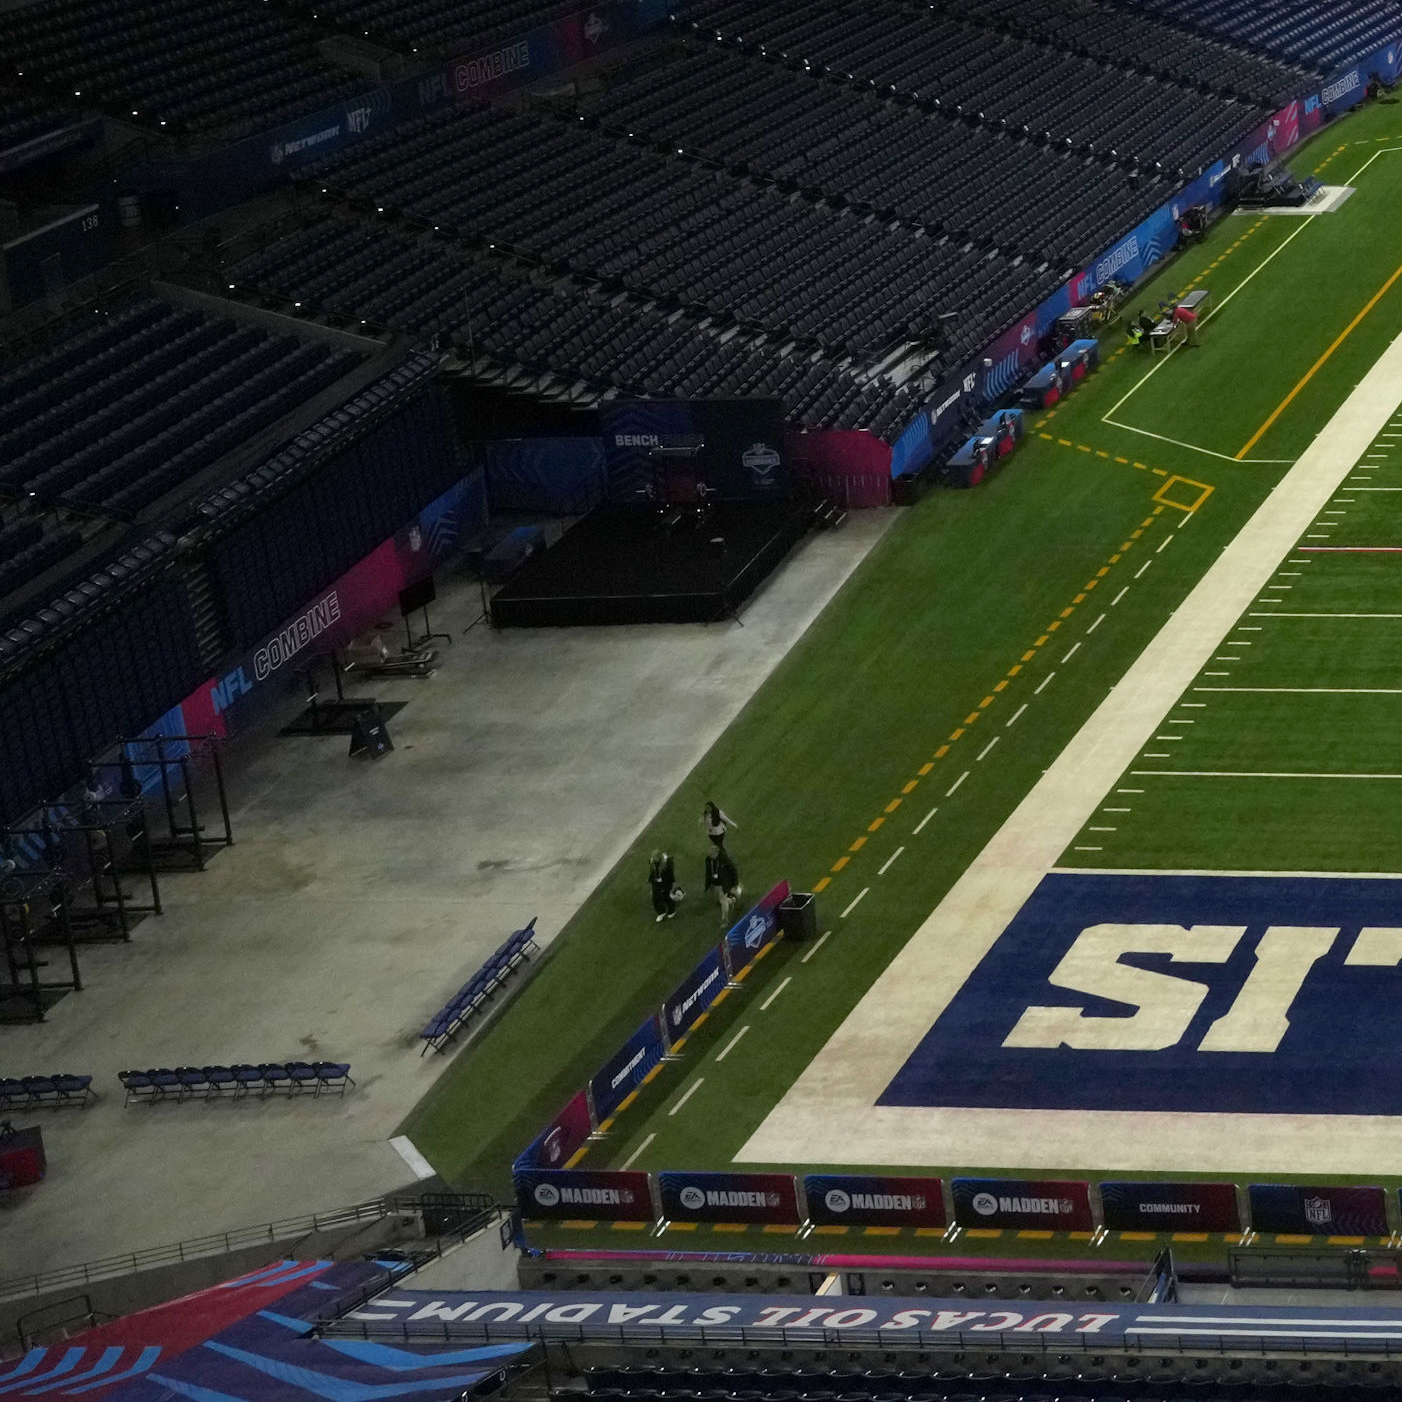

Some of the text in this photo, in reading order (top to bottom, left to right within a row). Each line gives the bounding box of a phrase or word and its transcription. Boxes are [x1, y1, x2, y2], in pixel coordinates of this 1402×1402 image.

[455, 40, 529, 93] COMBINE
[285, 124, 341, 157] NETWORK
[82, 214, 99, 232] 138
[1096, 235, 1140, 286] COMBINE
[615, 434, 659, 447] BENCH
[211, 590, 342, 716] NFL COMBINE
[682, 966, 721, 1014] NETWORK
[560, 1187, 621, 1205] MADDEN
[706, 1190, 767, 1208] MADDEN
[852, 1193, 912, 1211] MADDEN
[998, 1197, 1060, 1215] MADDEN
[1138, 1202, 1201, 1214] COMMUNITY
[407, 1300, 1119, 1335] LUCAS OIL STADIUM
